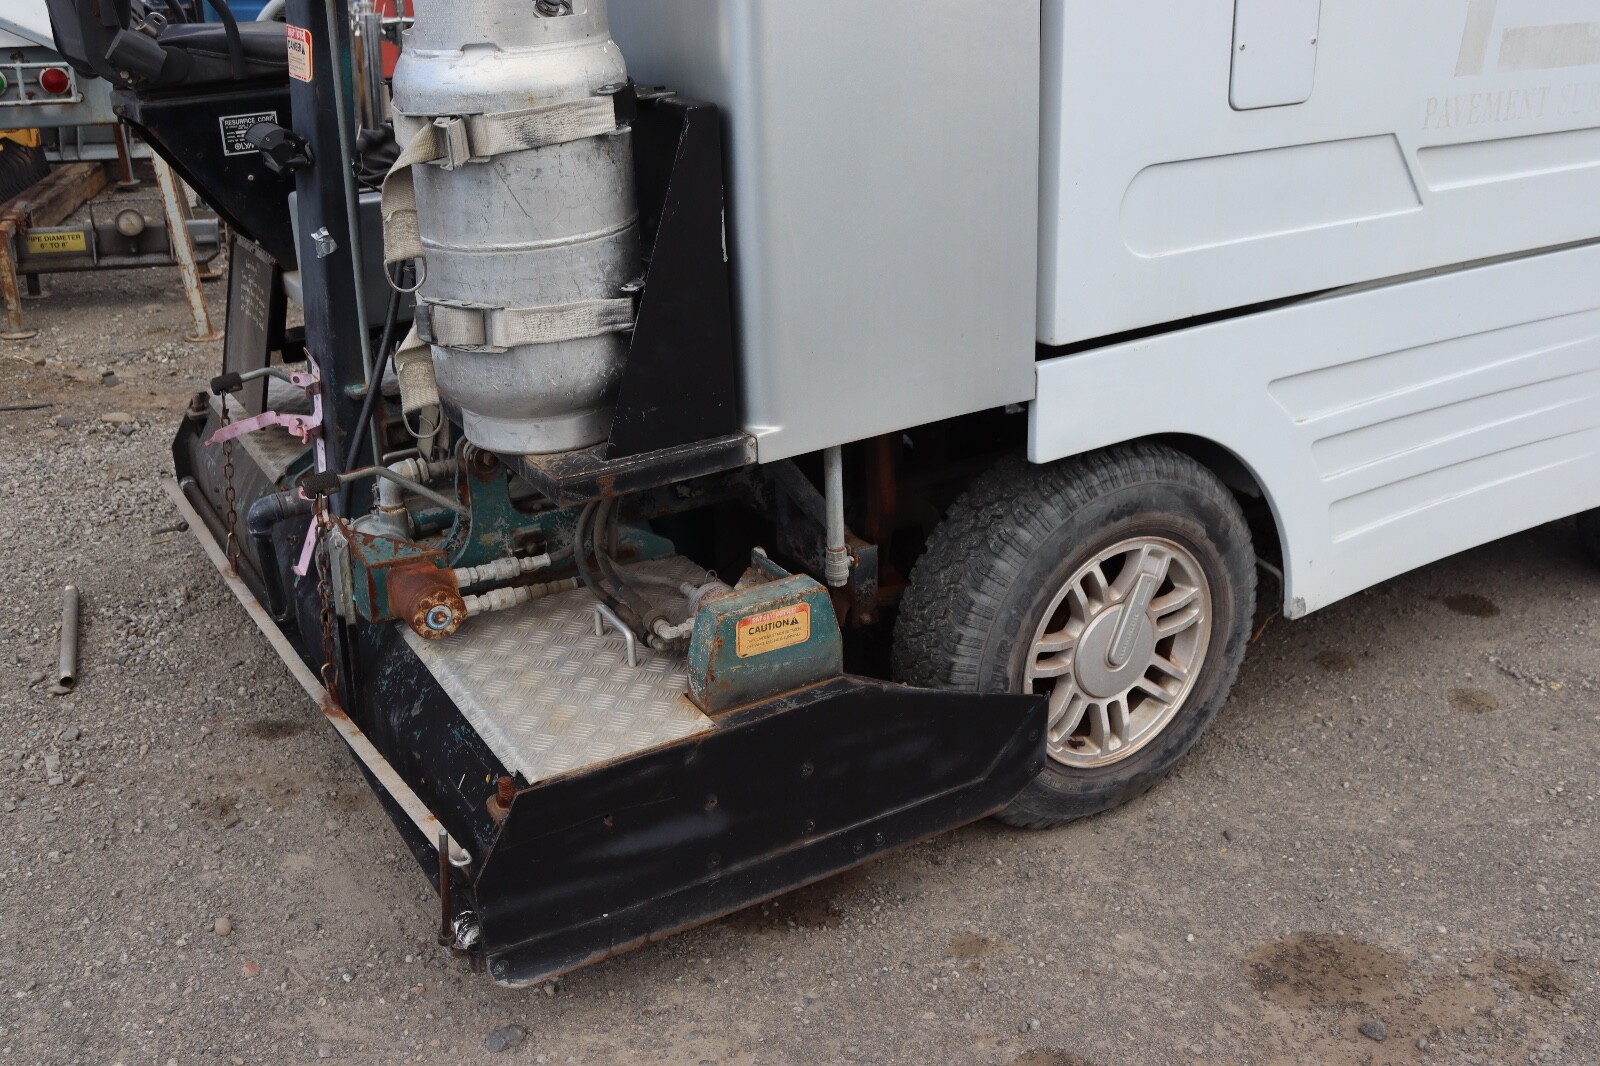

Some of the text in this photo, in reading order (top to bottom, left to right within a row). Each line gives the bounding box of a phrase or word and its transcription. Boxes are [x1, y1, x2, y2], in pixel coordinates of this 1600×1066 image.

[1422, 86, 1551, 130] PAVEMENT
[44, 233, 81, 242] DIAMETER
[748, 618, 789, 635] CAUTION
